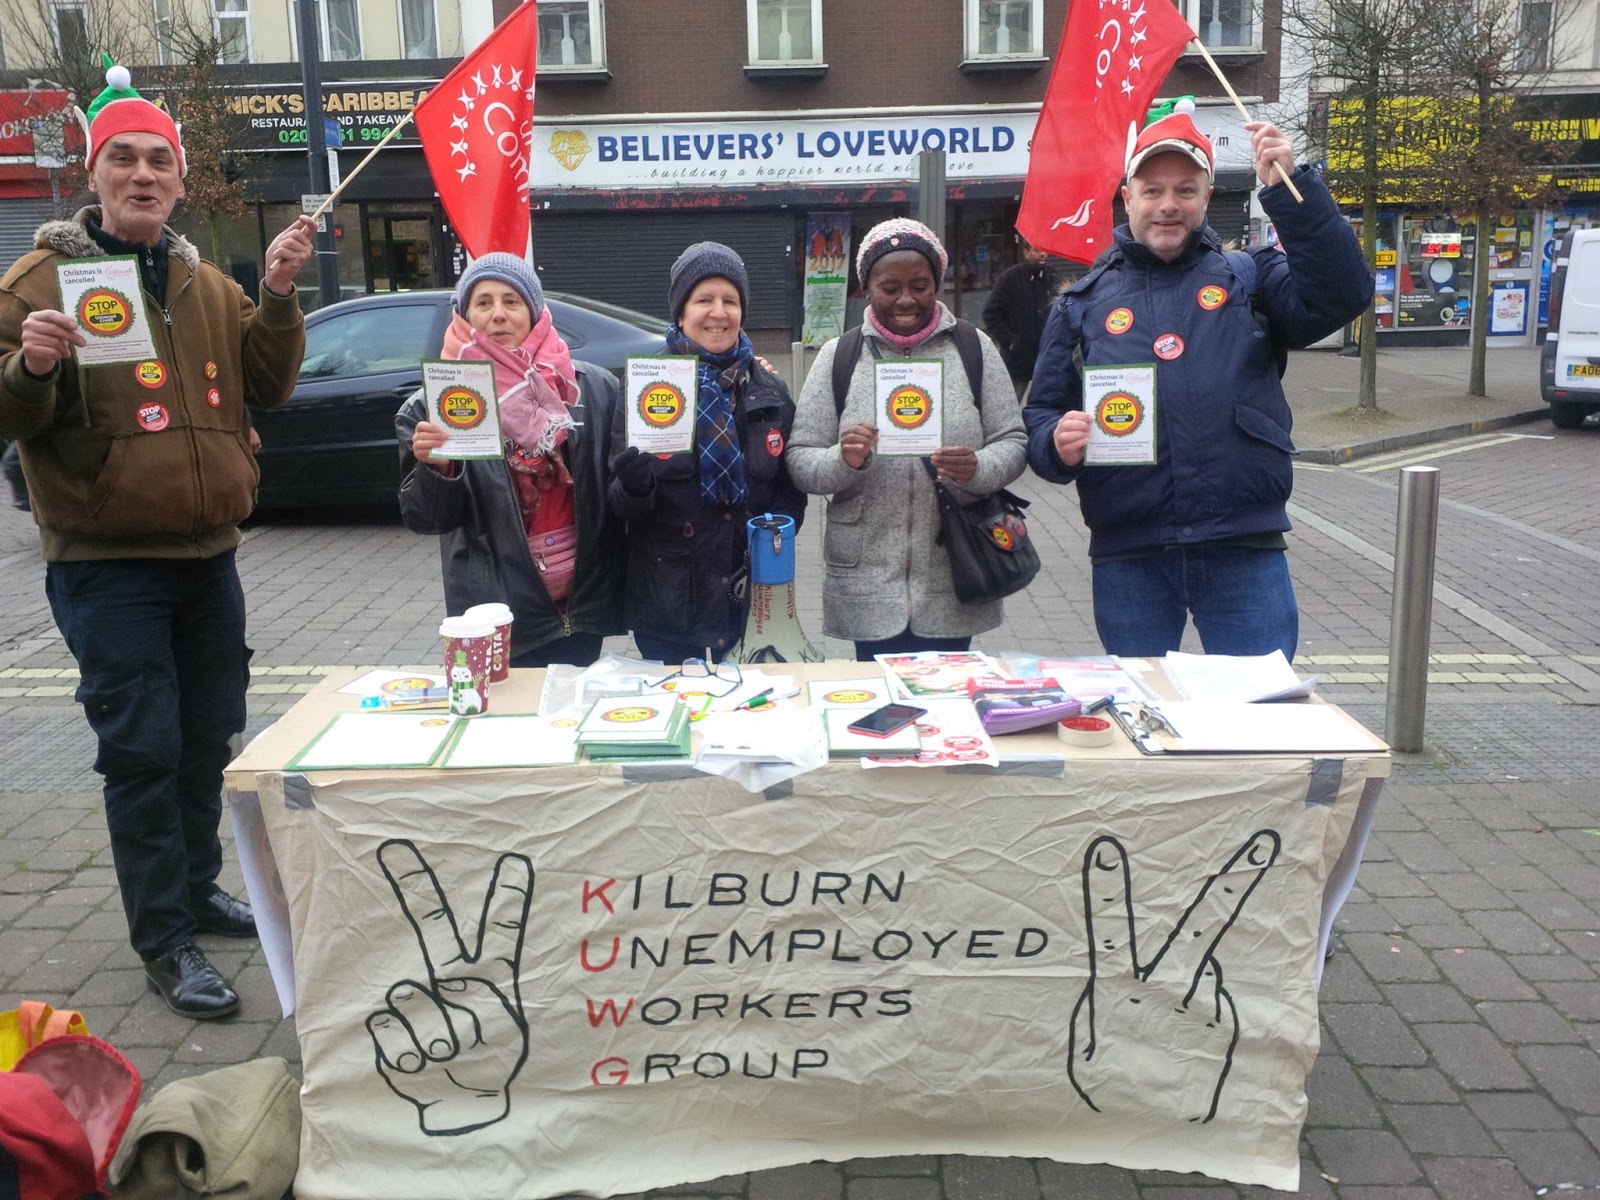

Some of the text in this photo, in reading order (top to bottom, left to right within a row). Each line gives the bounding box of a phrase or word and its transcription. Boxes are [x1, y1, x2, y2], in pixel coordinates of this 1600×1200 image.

[597, 131, 784, 162] BELIEVERS'
[797, 125, 1015, 158] LOVEWORLD
[756, 166, 824, 178] happier
[834, 163, 883, 174] world
[808, 255, 846, 271] 2017
[1206, 289, 1222, 298] STOP
[88, 300, 118, 311] STOP
[1154, 336, 1176, 349] STOP
[427, 367, 456, 375] Christmas
[448, 397, 474, 406] STOP
[649, 393, 675, 402] STOP
[896, 396, 921, 405] STOP
[139, 405, 161, 417] STOP
[1107, 403, 1132, 411] STOP
[493, 632, 503, 671] COSTA
[581, 870, 905, 914] KILBURN
[580, 928, 1049, 972] UNEMPLOYED
[586, 989, 912, 1028] WORKERS
[591, 1049, 829, 1086] GROUP
